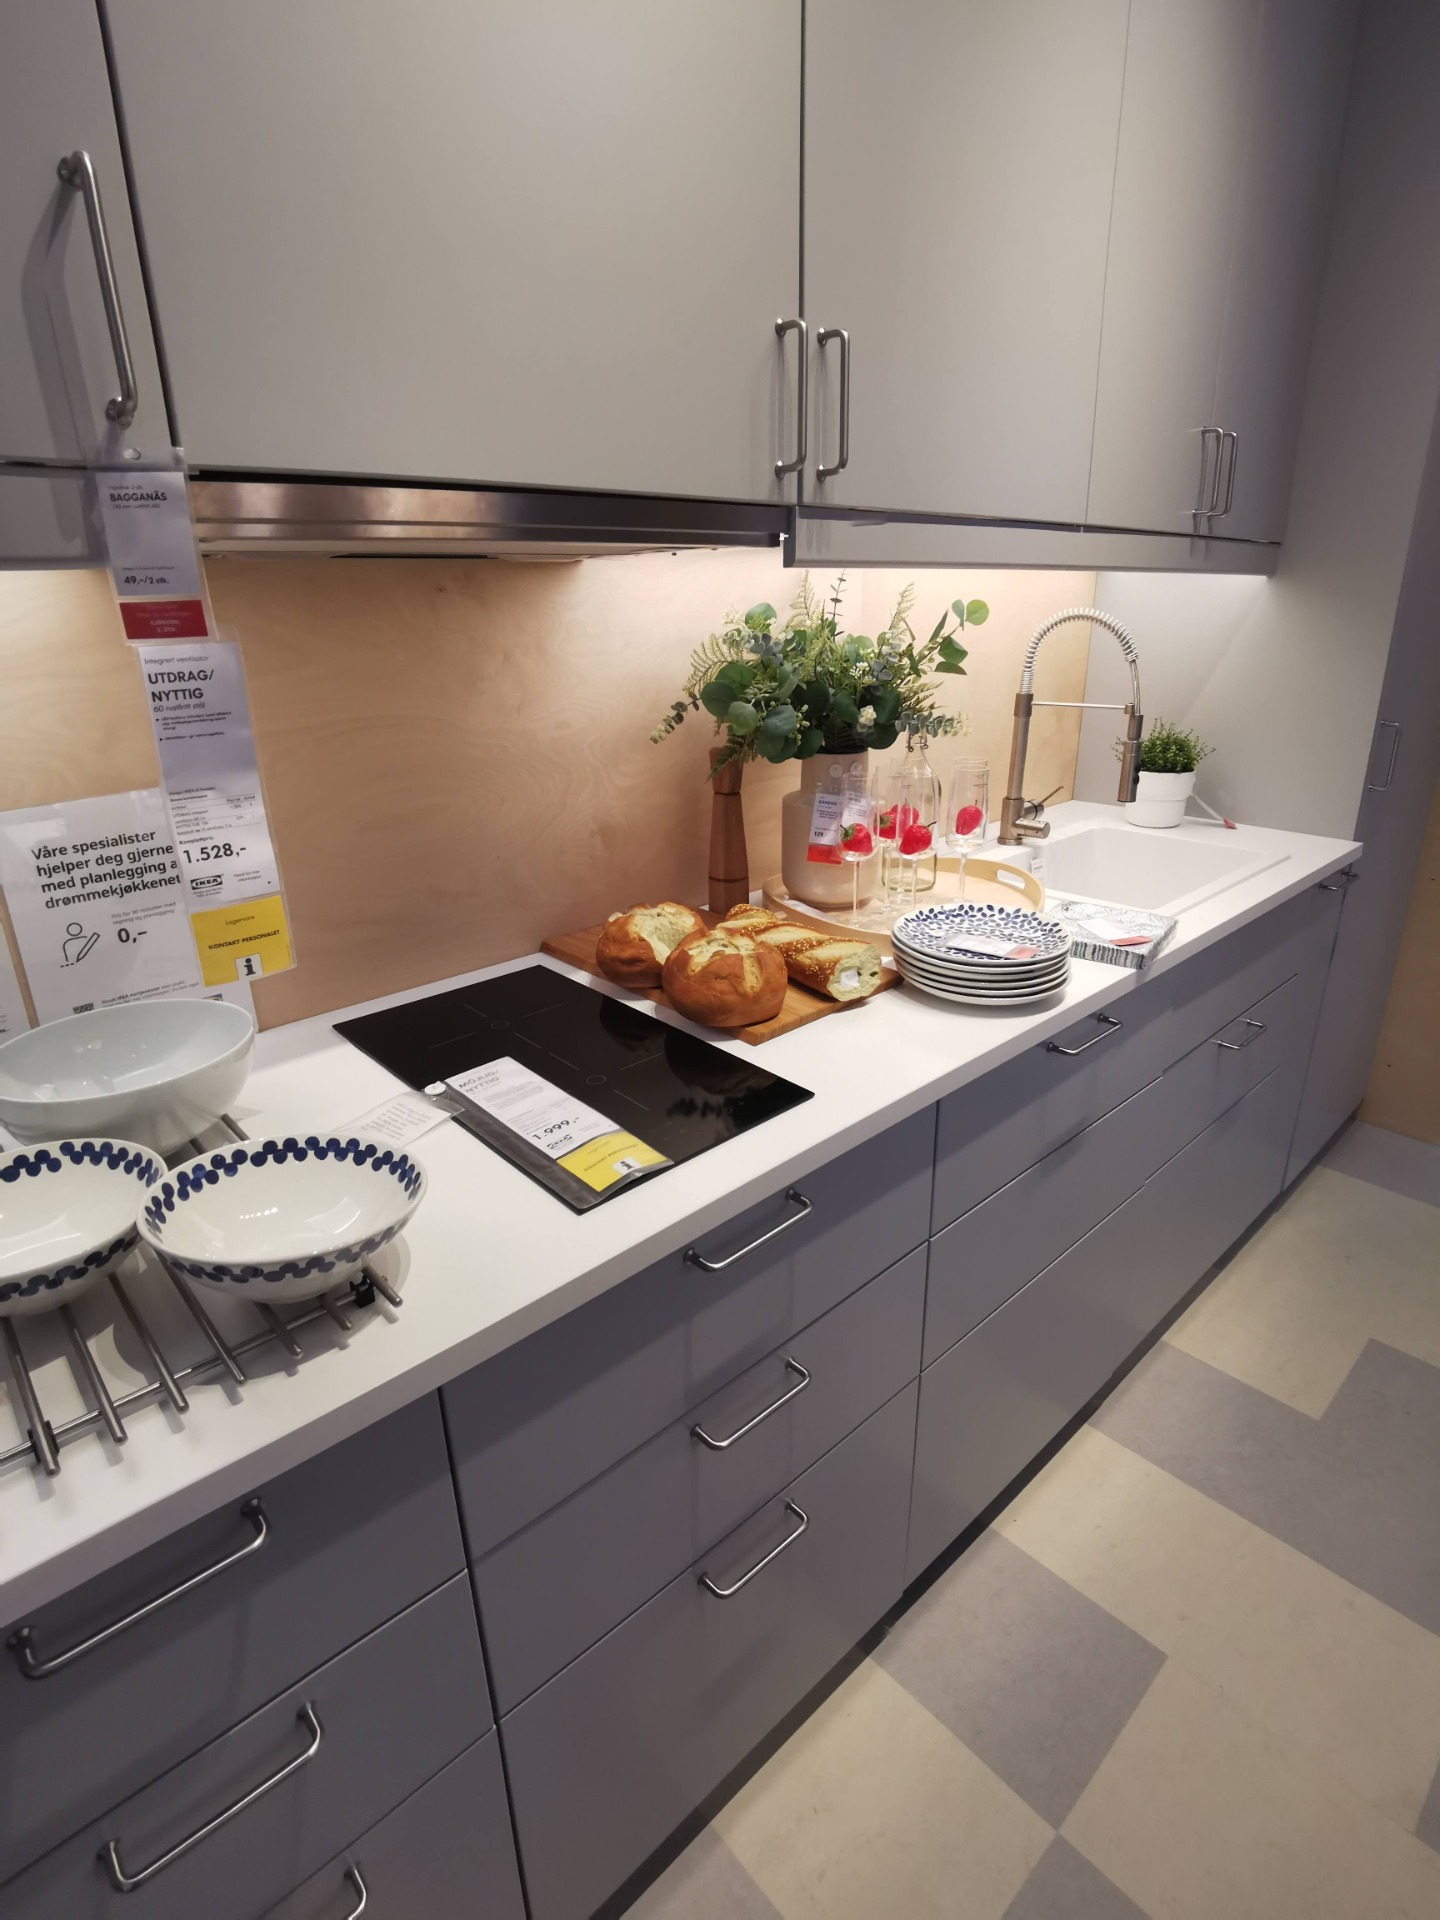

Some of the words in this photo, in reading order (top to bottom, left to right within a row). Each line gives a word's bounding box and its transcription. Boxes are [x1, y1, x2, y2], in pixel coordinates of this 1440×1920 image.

[109, 491, 168, 502] BAGGANÄS
[144, 656, 176, 666] Integrert
[176, 654, 209, 662] ventilator
[147, 669, 214, 685] UTDRAG/
[151, 687, 204, 702] NYTTIG
[153, 705, 164, 713] 60
[165, 703, 191, 712] rustfritt
[192, 701, 206, 709] stål
[31, 845, 68, 861] Våre
[72, 831, 156, 856] spesialister
[183, 842, 247, 864] 1.528,-
[36, 857, 91, 879] hjelper
[95, 853, 124, 867] deg
[127, 845, 174, 864] gjerne
[41, 876, 76, 893] med
[80, 862, 167, 889] planlegging
[224, 915, 255, 926] Lagervare
[208, 938, 241, 950] KONTAKT
[241, 929, 280, 943] PERSONALET
[464, 1076, 500, 1094] NYTTIG
